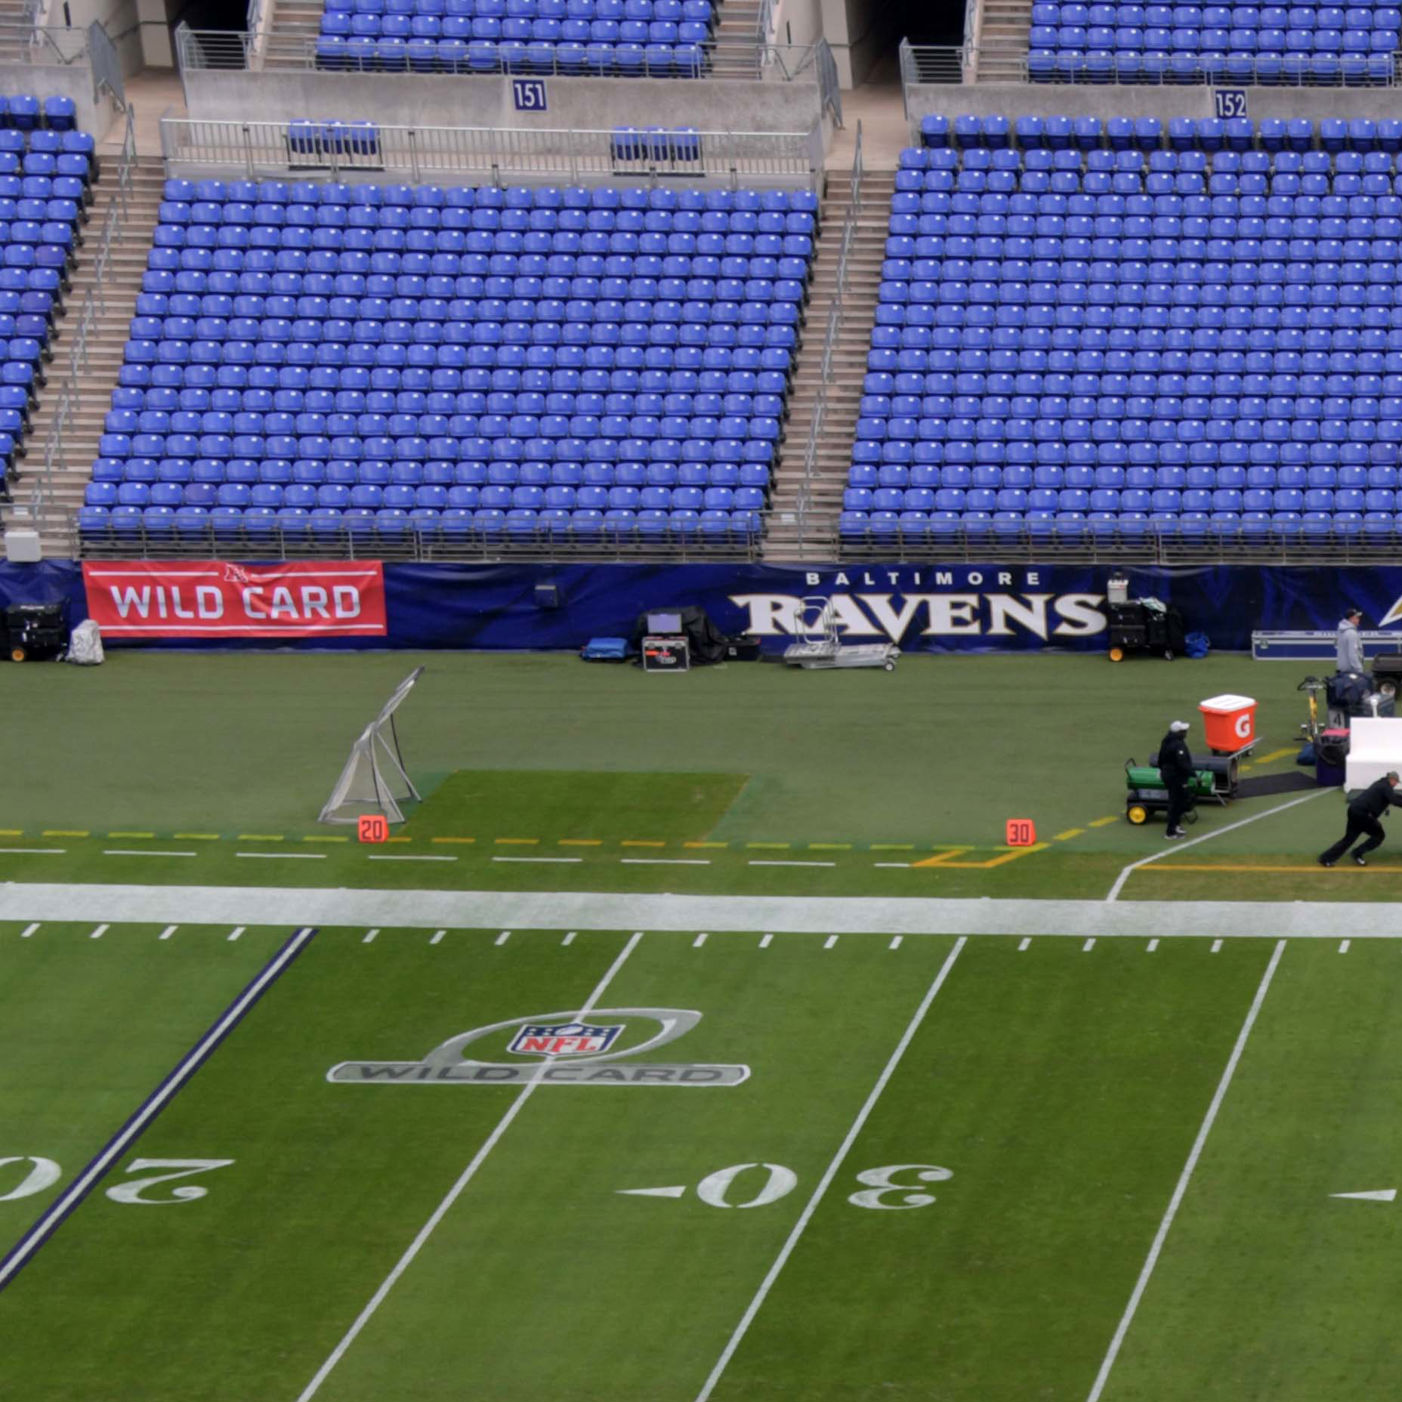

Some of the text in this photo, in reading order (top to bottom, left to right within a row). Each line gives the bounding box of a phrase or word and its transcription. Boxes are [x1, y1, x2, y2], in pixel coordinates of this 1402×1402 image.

[514, 83, 544, 107] 151
[1216, 93, 1246, 117] 152
[806, 571, 1040, 586] BALTIMORE
[110, 585, 361, 619] WILD CARD
[728, 592, 1107, 643] RAVENS
[1235, 714, 1250, 738] G
[361, 819, 382, 840] 20
[1009, 823, 1030, 843] 30
[522, 1036, 596, 1052] NFL
[358, 1065, 723, 1083] WILD CARD
